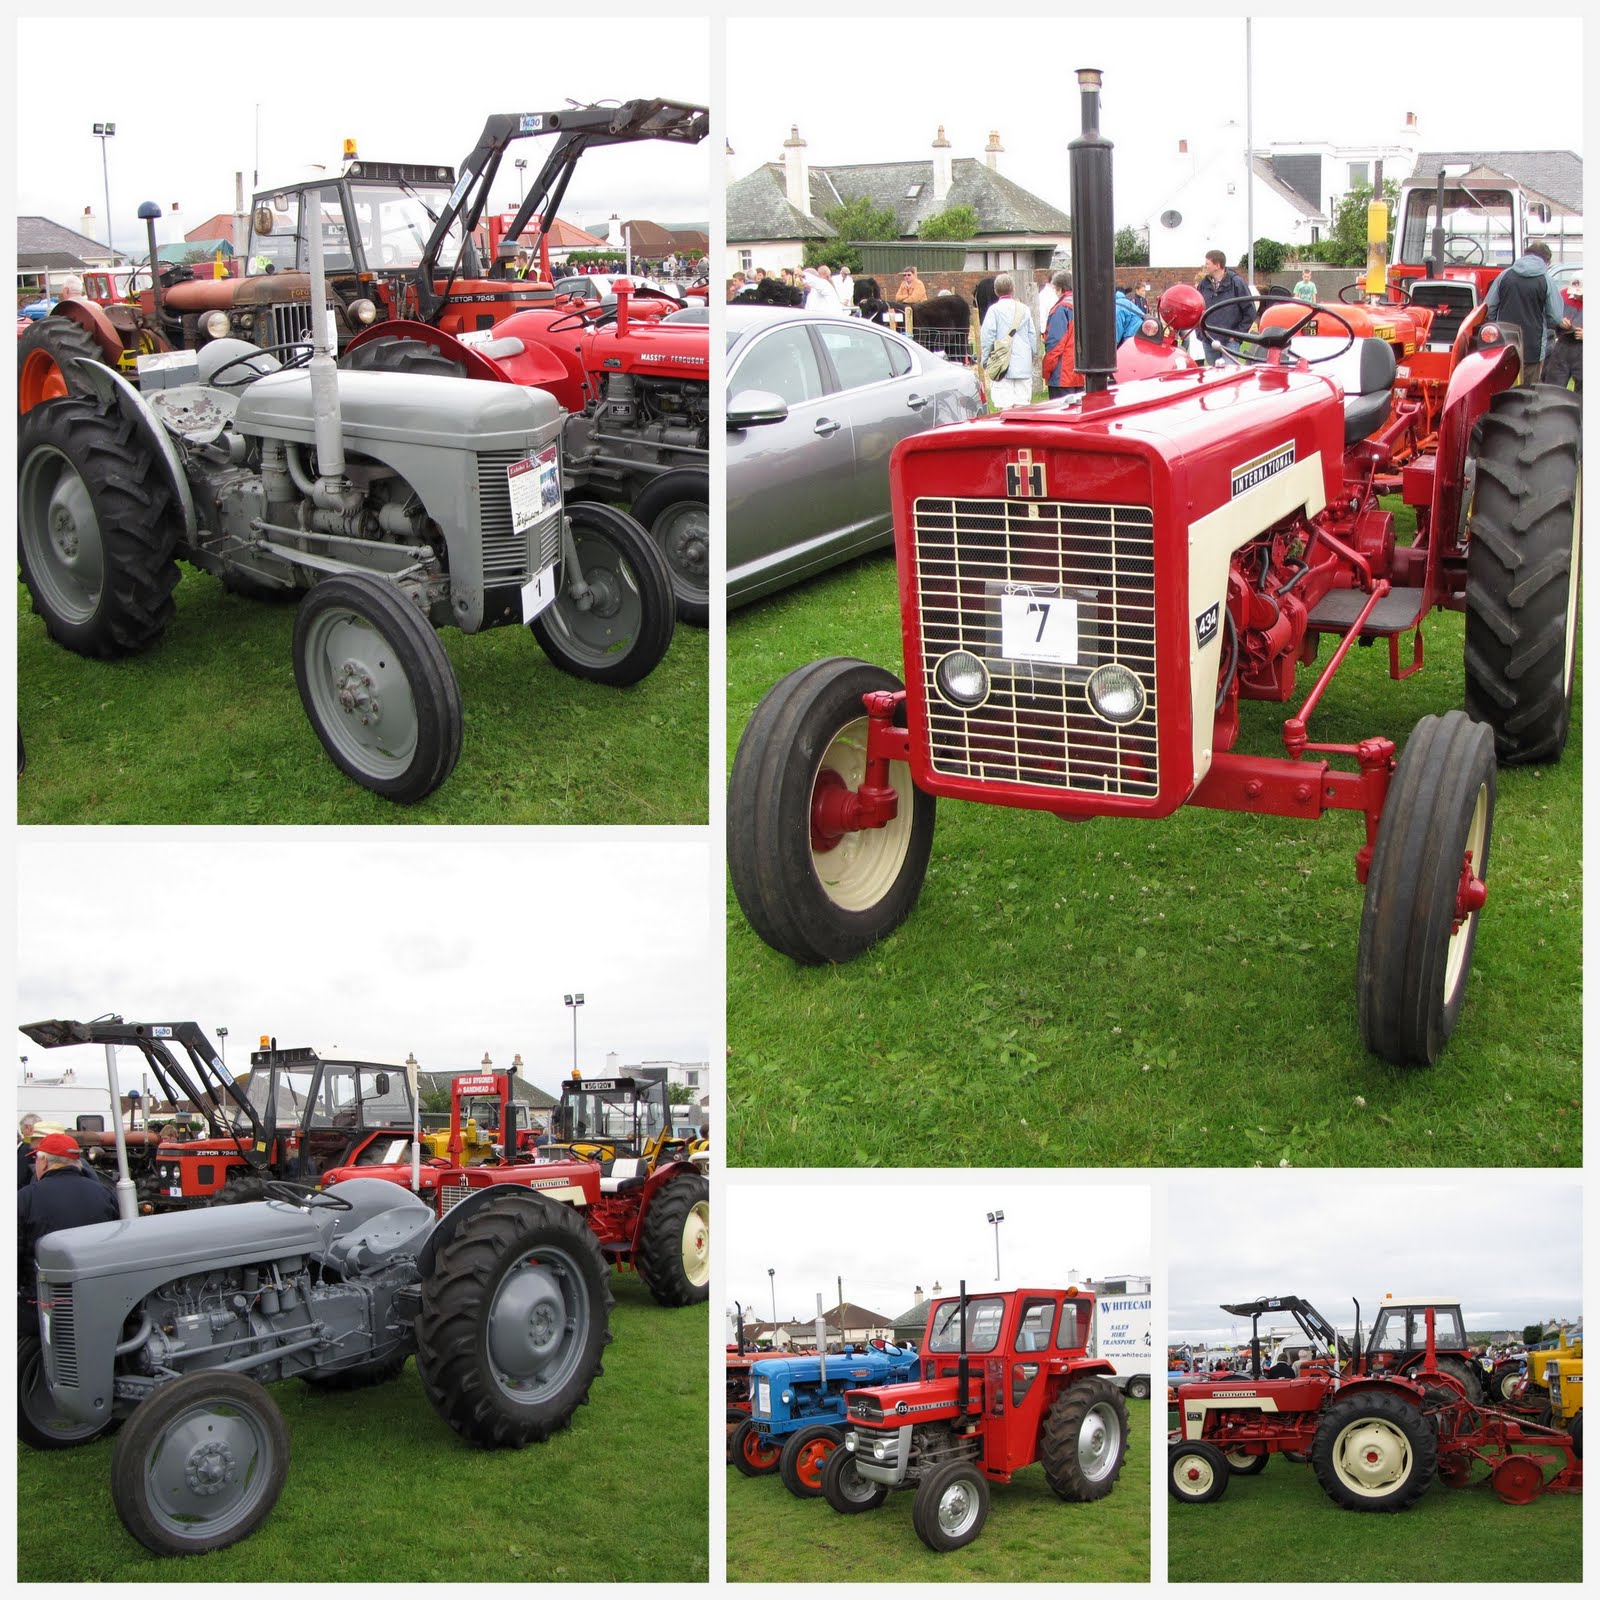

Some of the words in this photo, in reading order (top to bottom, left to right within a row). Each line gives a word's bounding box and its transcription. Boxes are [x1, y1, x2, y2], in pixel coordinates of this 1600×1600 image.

[477, 294, 496, 302] 7245
[641, 353, 666, 362] MASSEY
[670, 355, 705, 365] FERGUSON
[1235, 452, 1292, 494] INTERNATIONAL
[535, 578, 542, 598] 1
[1027, 603, 1051, 643] 7
[1199, 608, 1217, 634] 434
[898, 1404, 908, 1413] 135
[909, 1404, 932, 1412] MASSEY
